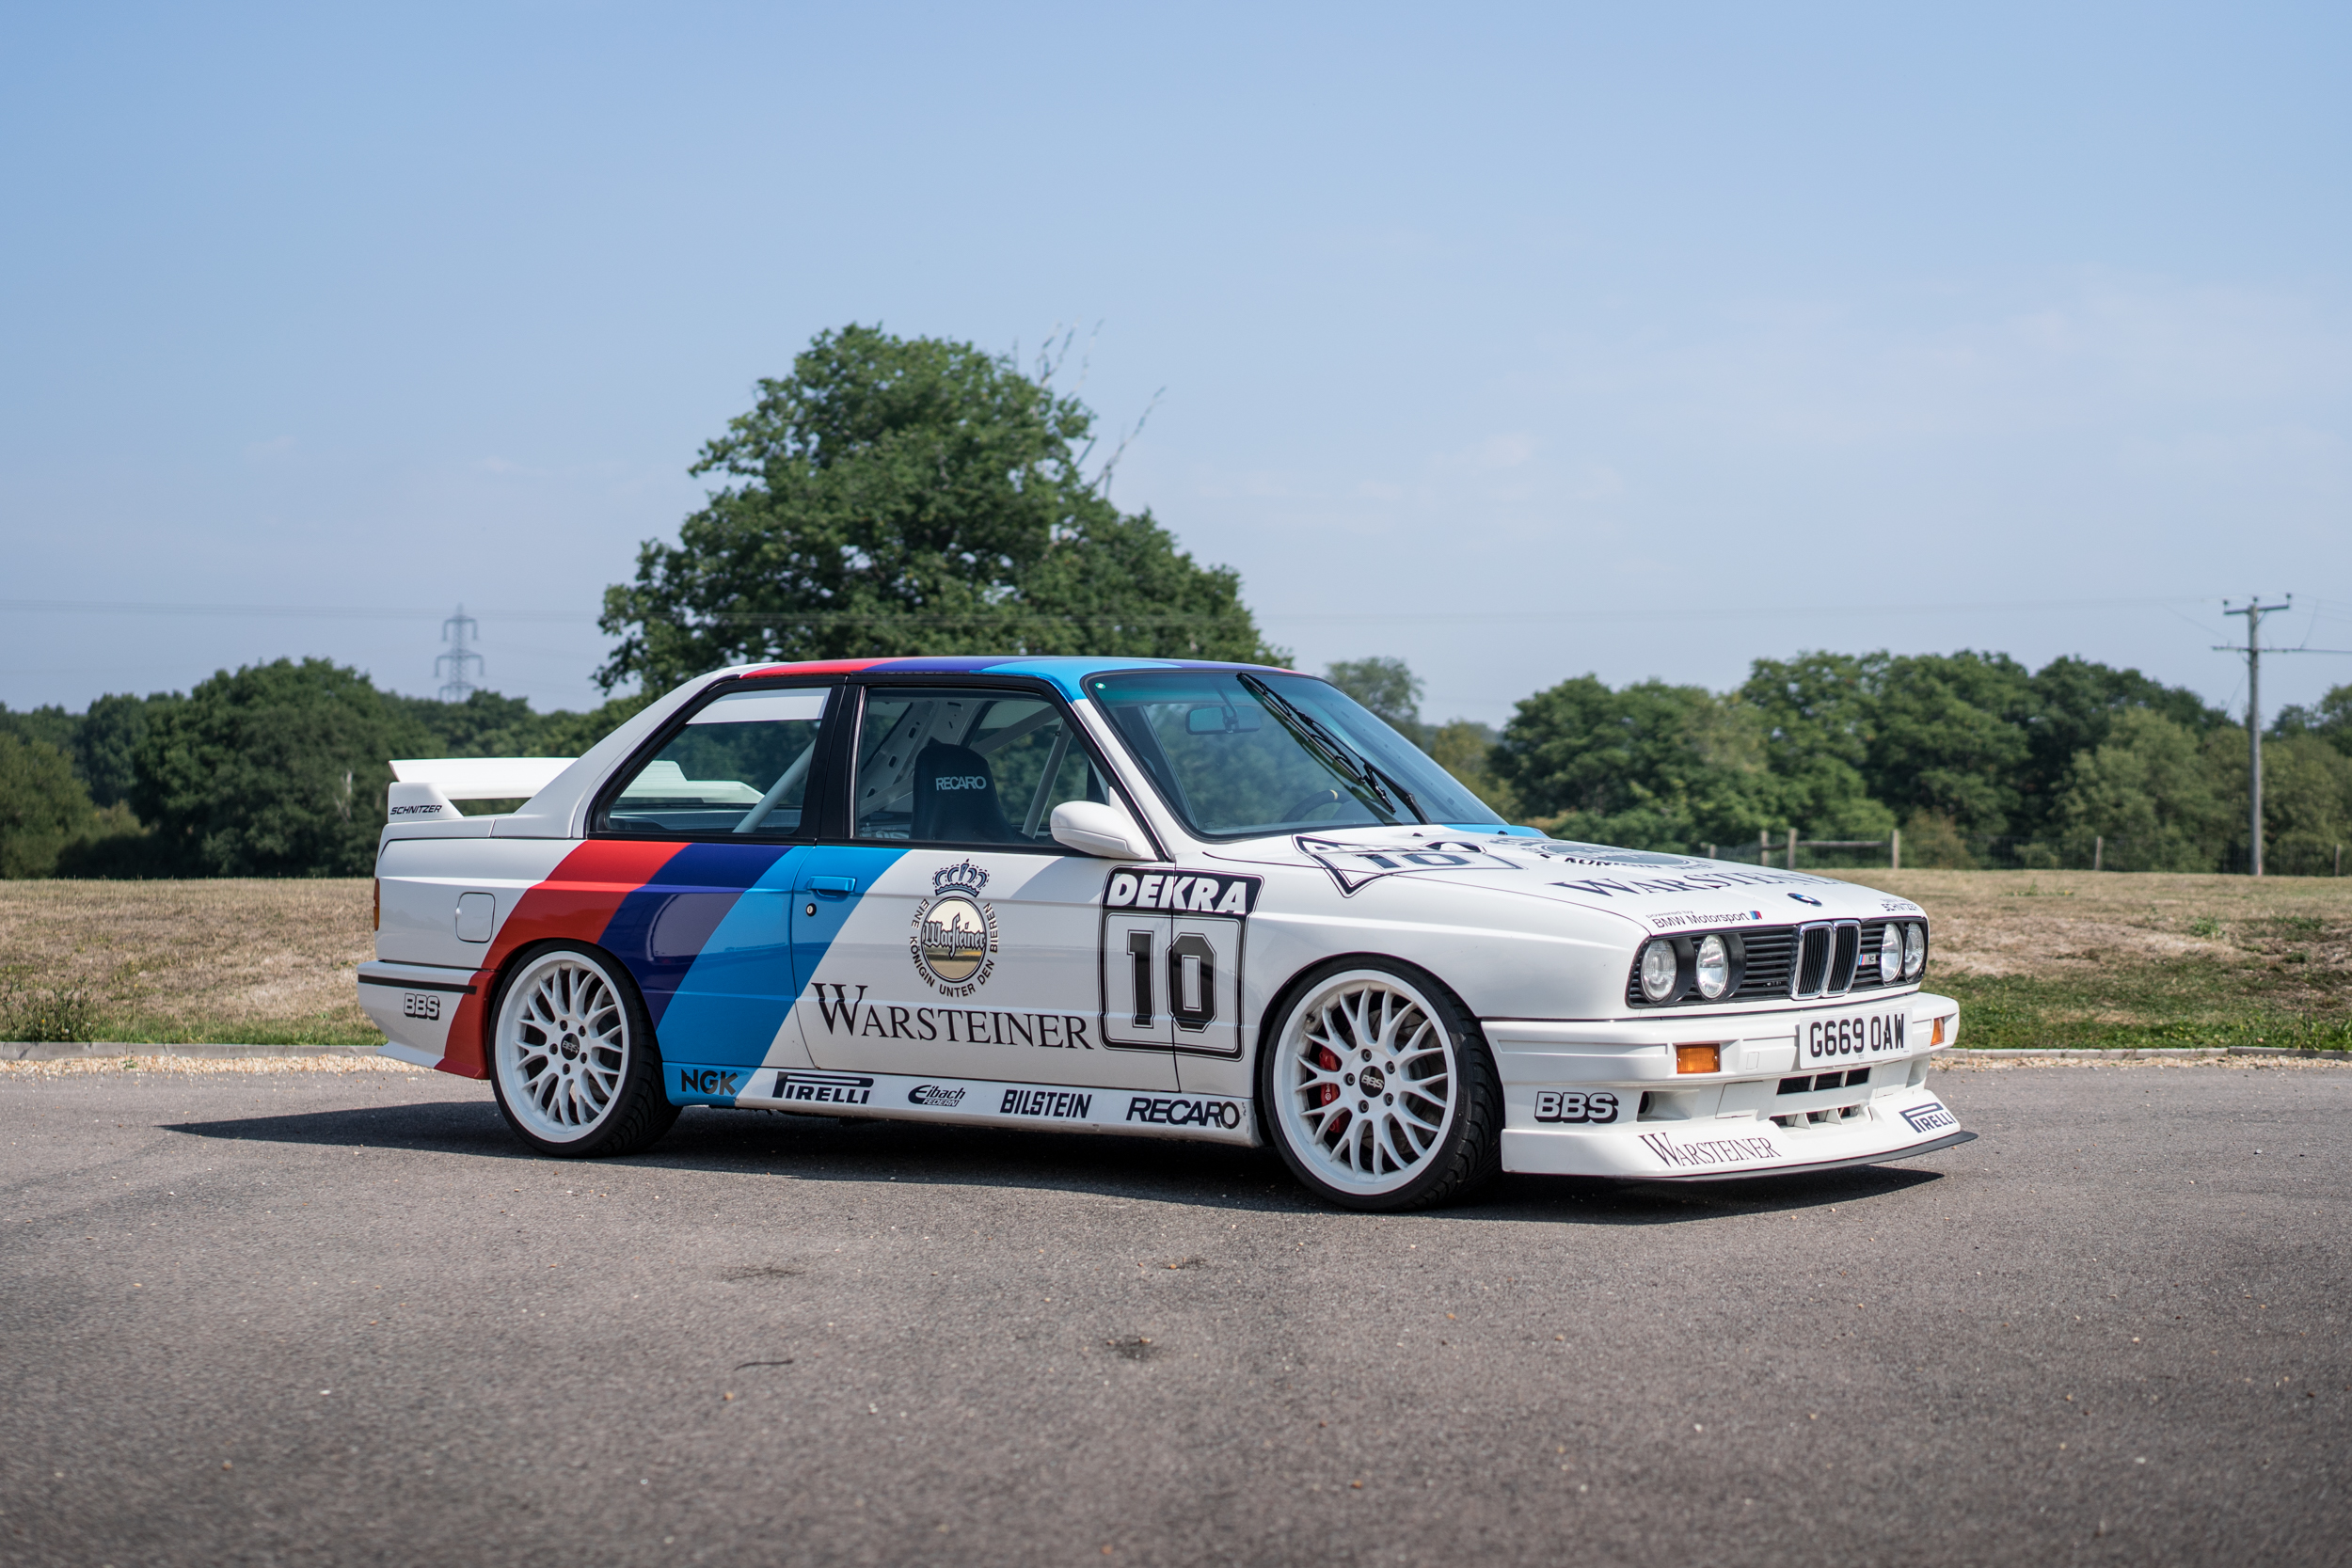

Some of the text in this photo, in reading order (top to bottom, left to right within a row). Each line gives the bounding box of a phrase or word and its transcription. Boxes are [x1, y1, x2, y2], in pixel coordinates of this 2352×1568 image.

[935, 775, 987, 791] RECARO
[389, 804, 443, 816] SCHNITZER
[1352, 852, 1475, 870] 10
[1106, 873, 1248, 915] DEKRA
[1646, 911, 1681, 919] powered
[1652, 912, 1751, 928] BMW Motorsport
[909, 898, 999, 998] EINE KÖNIGIN UNTER DEN BIEREN
[1127, 929, 1218, 1034] 10
[404, 992, 440, 1021] BBS
[811, 982, 1095, 1051] WARSTEINER
[562, 1039, 580, 1053] BBS
[1810, 1013, 1904, 1057] G669 OAW
[680, 1069, 741, 1096] NGK
[771, 1070, 875, 1105] PIRELLI
[908, 1085, 966, 1104] Eibach
[1360, 1074, 1385, 1090] BBS
[922, 1098, 960, 1107] FEDERN
[1000, 1089, 1092, 1119] BILSTEIN
[1125, 1097, 1240, 1130] RECARO
[1534, 1090, 1619, 1124] BBS
[1899, 1101, 1957, 1133] PIRELLI
[1638, 1132, 1783, 1168] WARSTEINER
